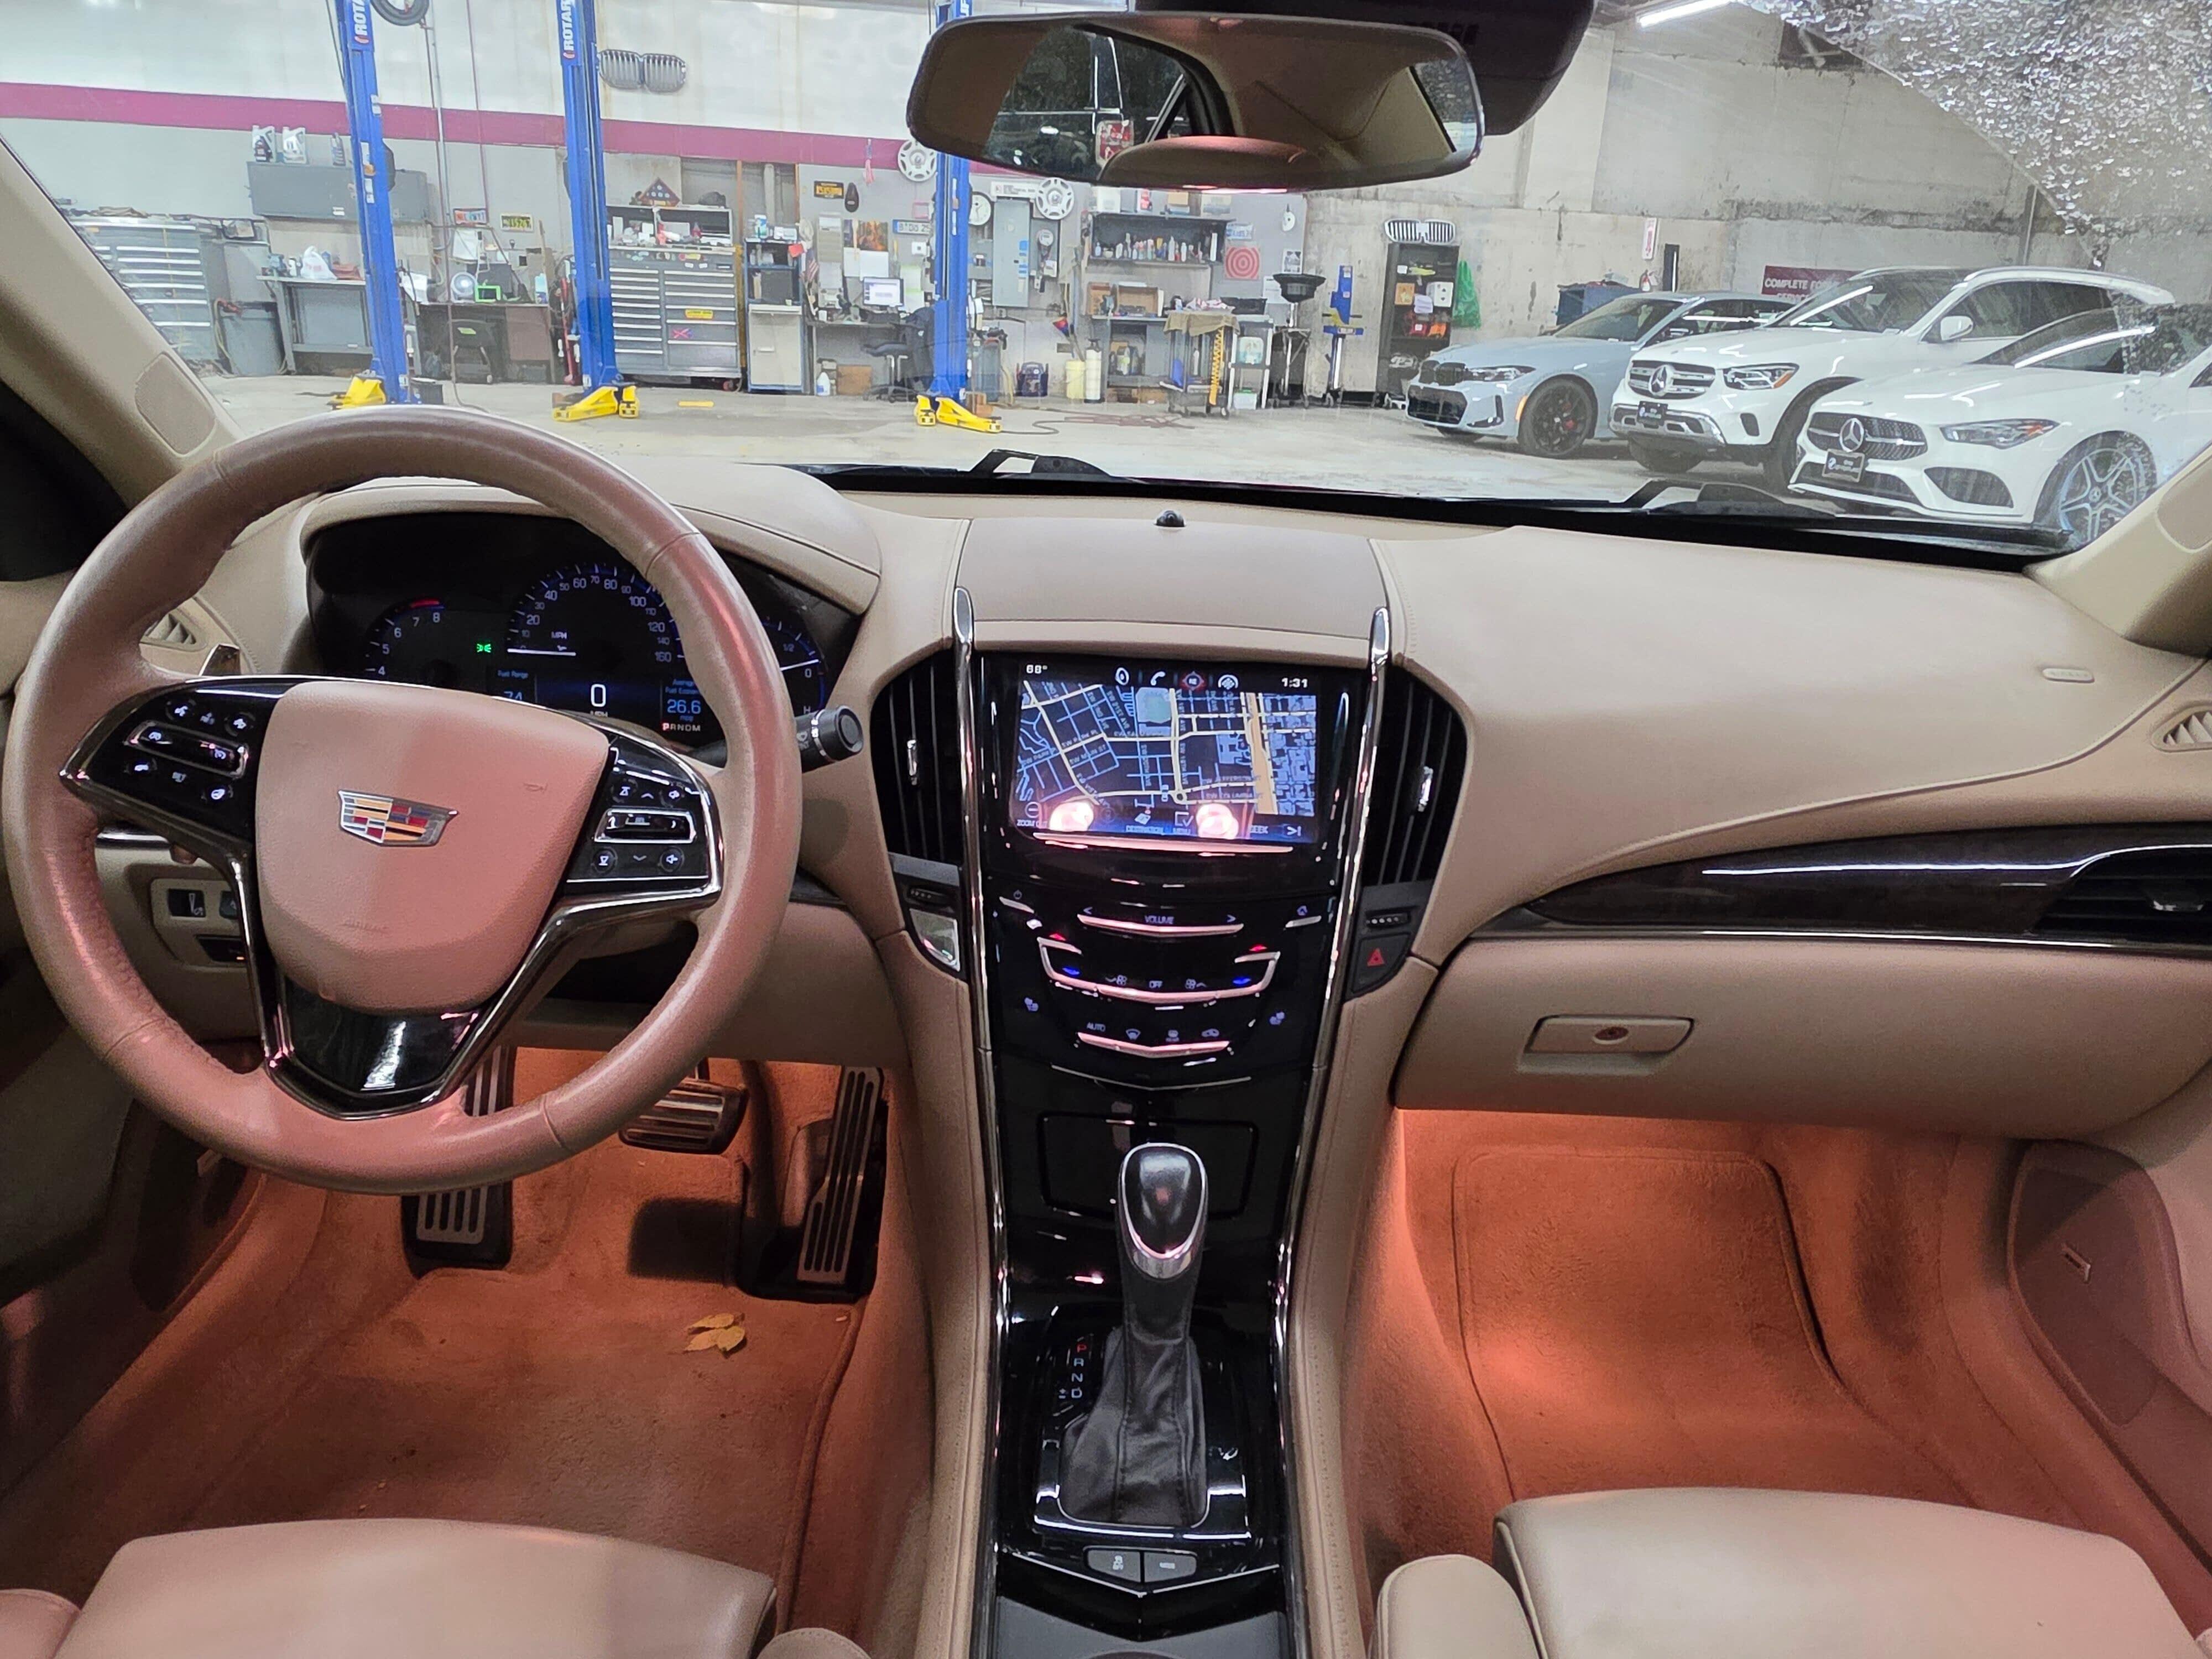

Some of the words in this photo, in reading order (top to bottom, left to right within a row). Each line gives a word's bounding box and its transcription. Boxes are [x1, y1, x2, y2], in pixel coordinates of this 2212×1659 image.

[1765, 278, 1808, 290] COMPLETE
[573, 578, 586, 588] 60
[591, 575, 599, 584] 70
[604, 579, 617, 589] 80
[559, 583, 570, 591] 50
[544, 590, 557, 601] 40
[535, 602, 545, 610] 30
[629, 596, 646, 607] 100
[413, 617, 420, 627] 7
[432, 612, 440, 623] 8
[526, 614, 540, 625] 20
[648, 622, 665, 633] 120
[394, 628, 401, 638] 6
[382, 643, 389, 654] 5
[655, 651, 672, 662] 160
[378, 666, 385, 675] 4
[805, 668, 812, 678] 0
[1282, 677, 1308, 688] 1:31
[591, 684, 606, 707] 0
[667, 699, 701, 714] 26.6
[1145, 915, 1174, 924] VOLUME
[1149, 980, 1162, 988] OFF
[1087, 1022, 1105, 1032] AUTO
[1077, 1344, 1087, 1353] P
[1074, 1358, 1084, 1366] R
[1072, 1373, 1083, 1382] N
[1071, 1386, 1082, 1399] D
